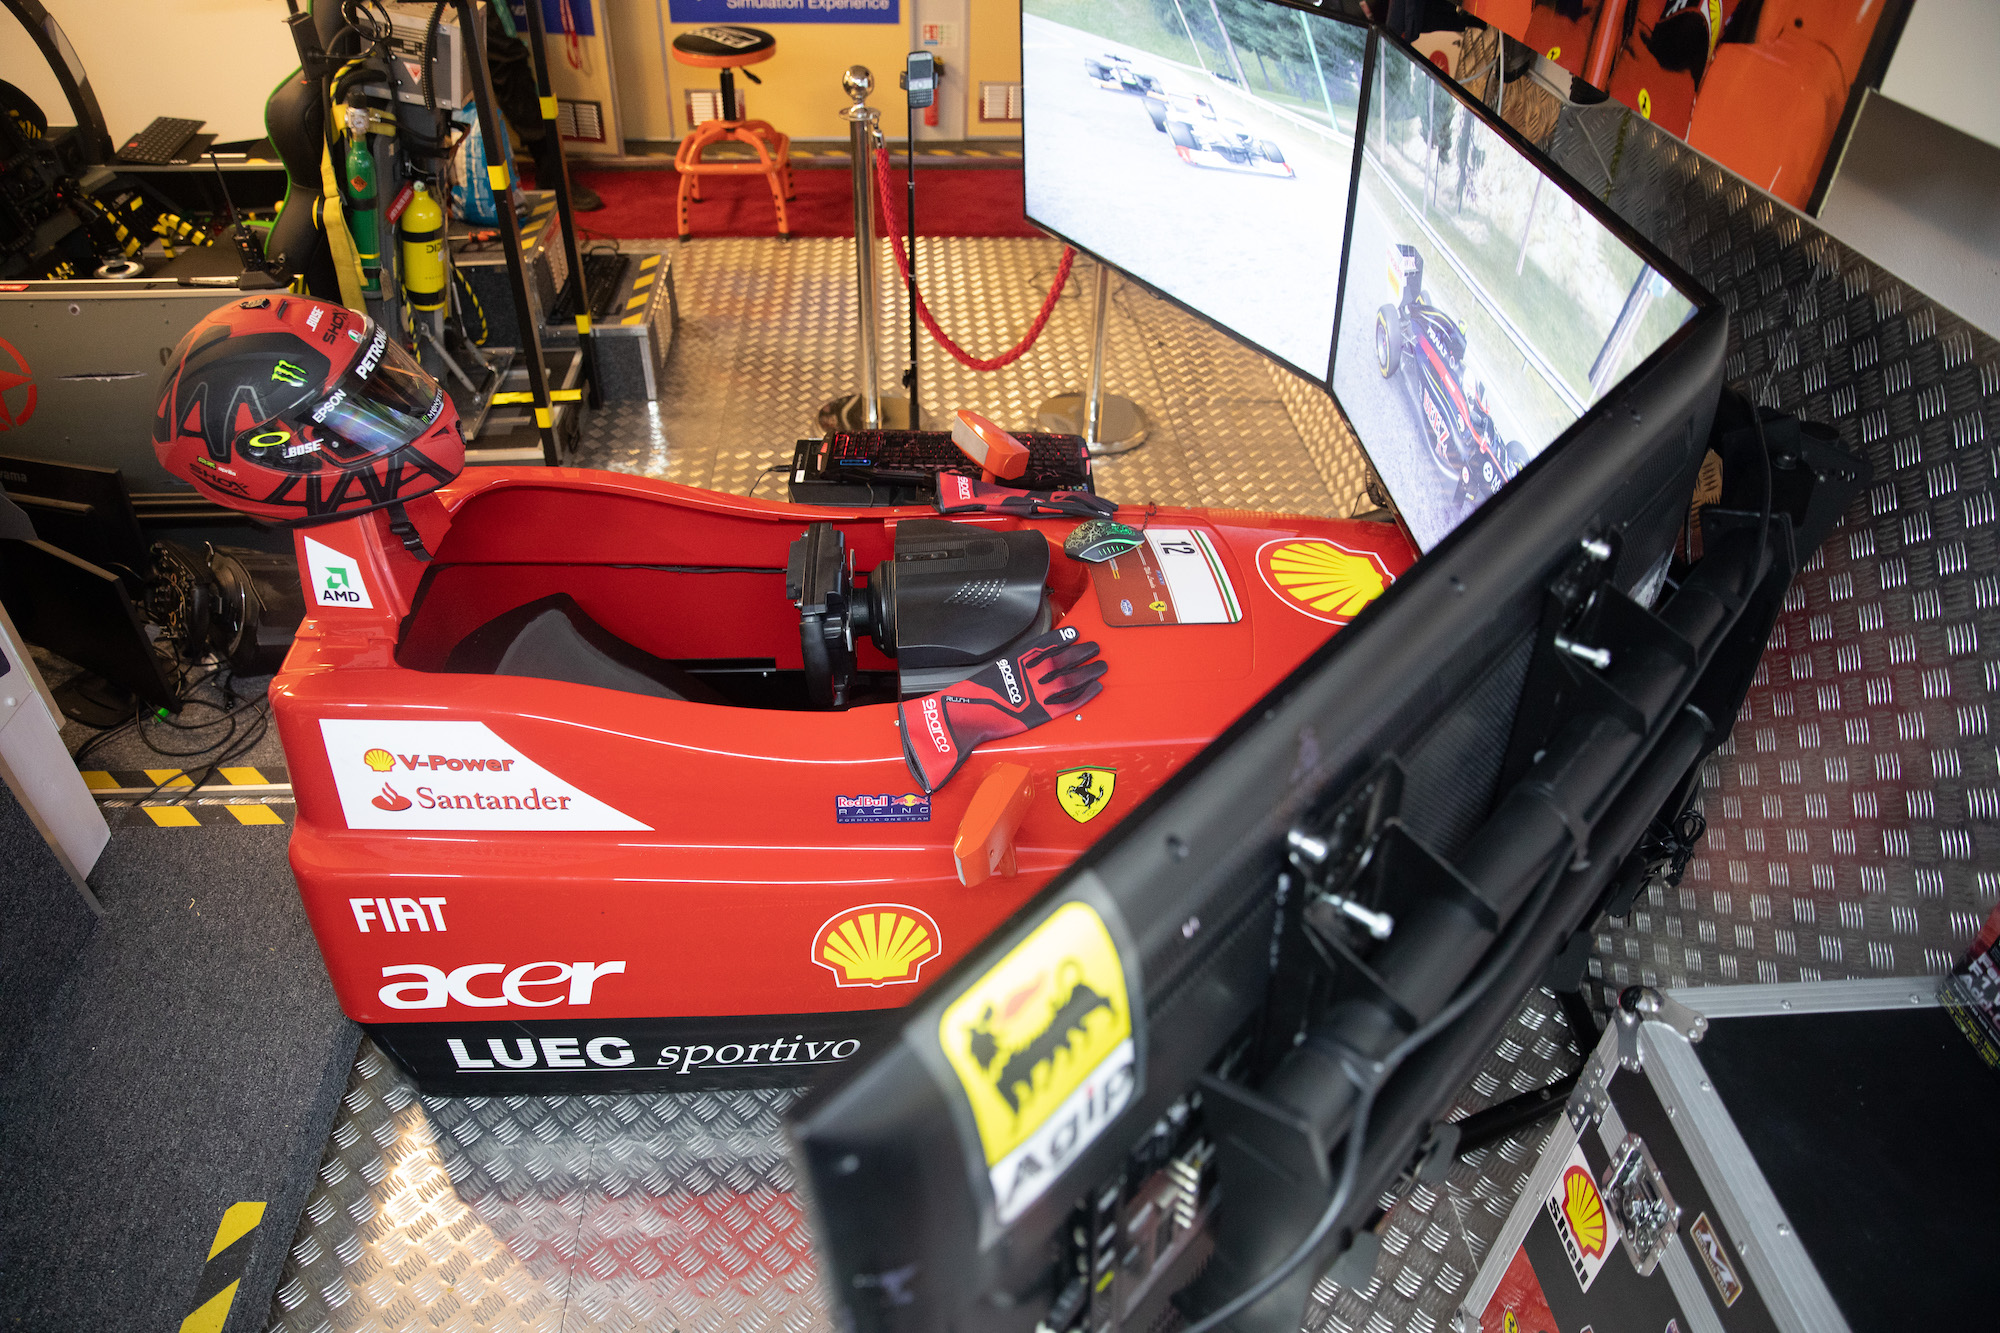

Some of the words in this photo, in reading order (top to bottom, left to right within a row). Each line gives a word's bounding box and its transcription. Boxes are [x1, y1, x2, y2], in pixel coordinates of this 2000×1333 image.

[726, 0, 803, 9] Simulation
[807, 0, 889, 12] Experience
[306, 305, 324, 332] BOSE
[312, 388, 347, 423] EPSON
[284, 438, 324, 459] BOSE
[1160, 541, 1195, 554] 12
[323, 590, 360, 602] AMD
[996, 658, 1022, 704] sparco
[922, 698, 950, 753] sparco
[397, 754, 515, 772] V-Power
[416, 786, 571, 810] Santander
[838, 796, 863, 808] Red
[863, 795, 888, 807] Bull
[838, 806, 929, 815] RACING
[348, 897, 447, 933] FIAT
[378, 960, 627, 1010] acer
[447, 1036, 636, 1069] LUEG
[656, 1034, 861, 1075] sportivo
[1004, 1063, 1134, 1206] Agip
[1549, 1197, 1589, 1286] Shell
